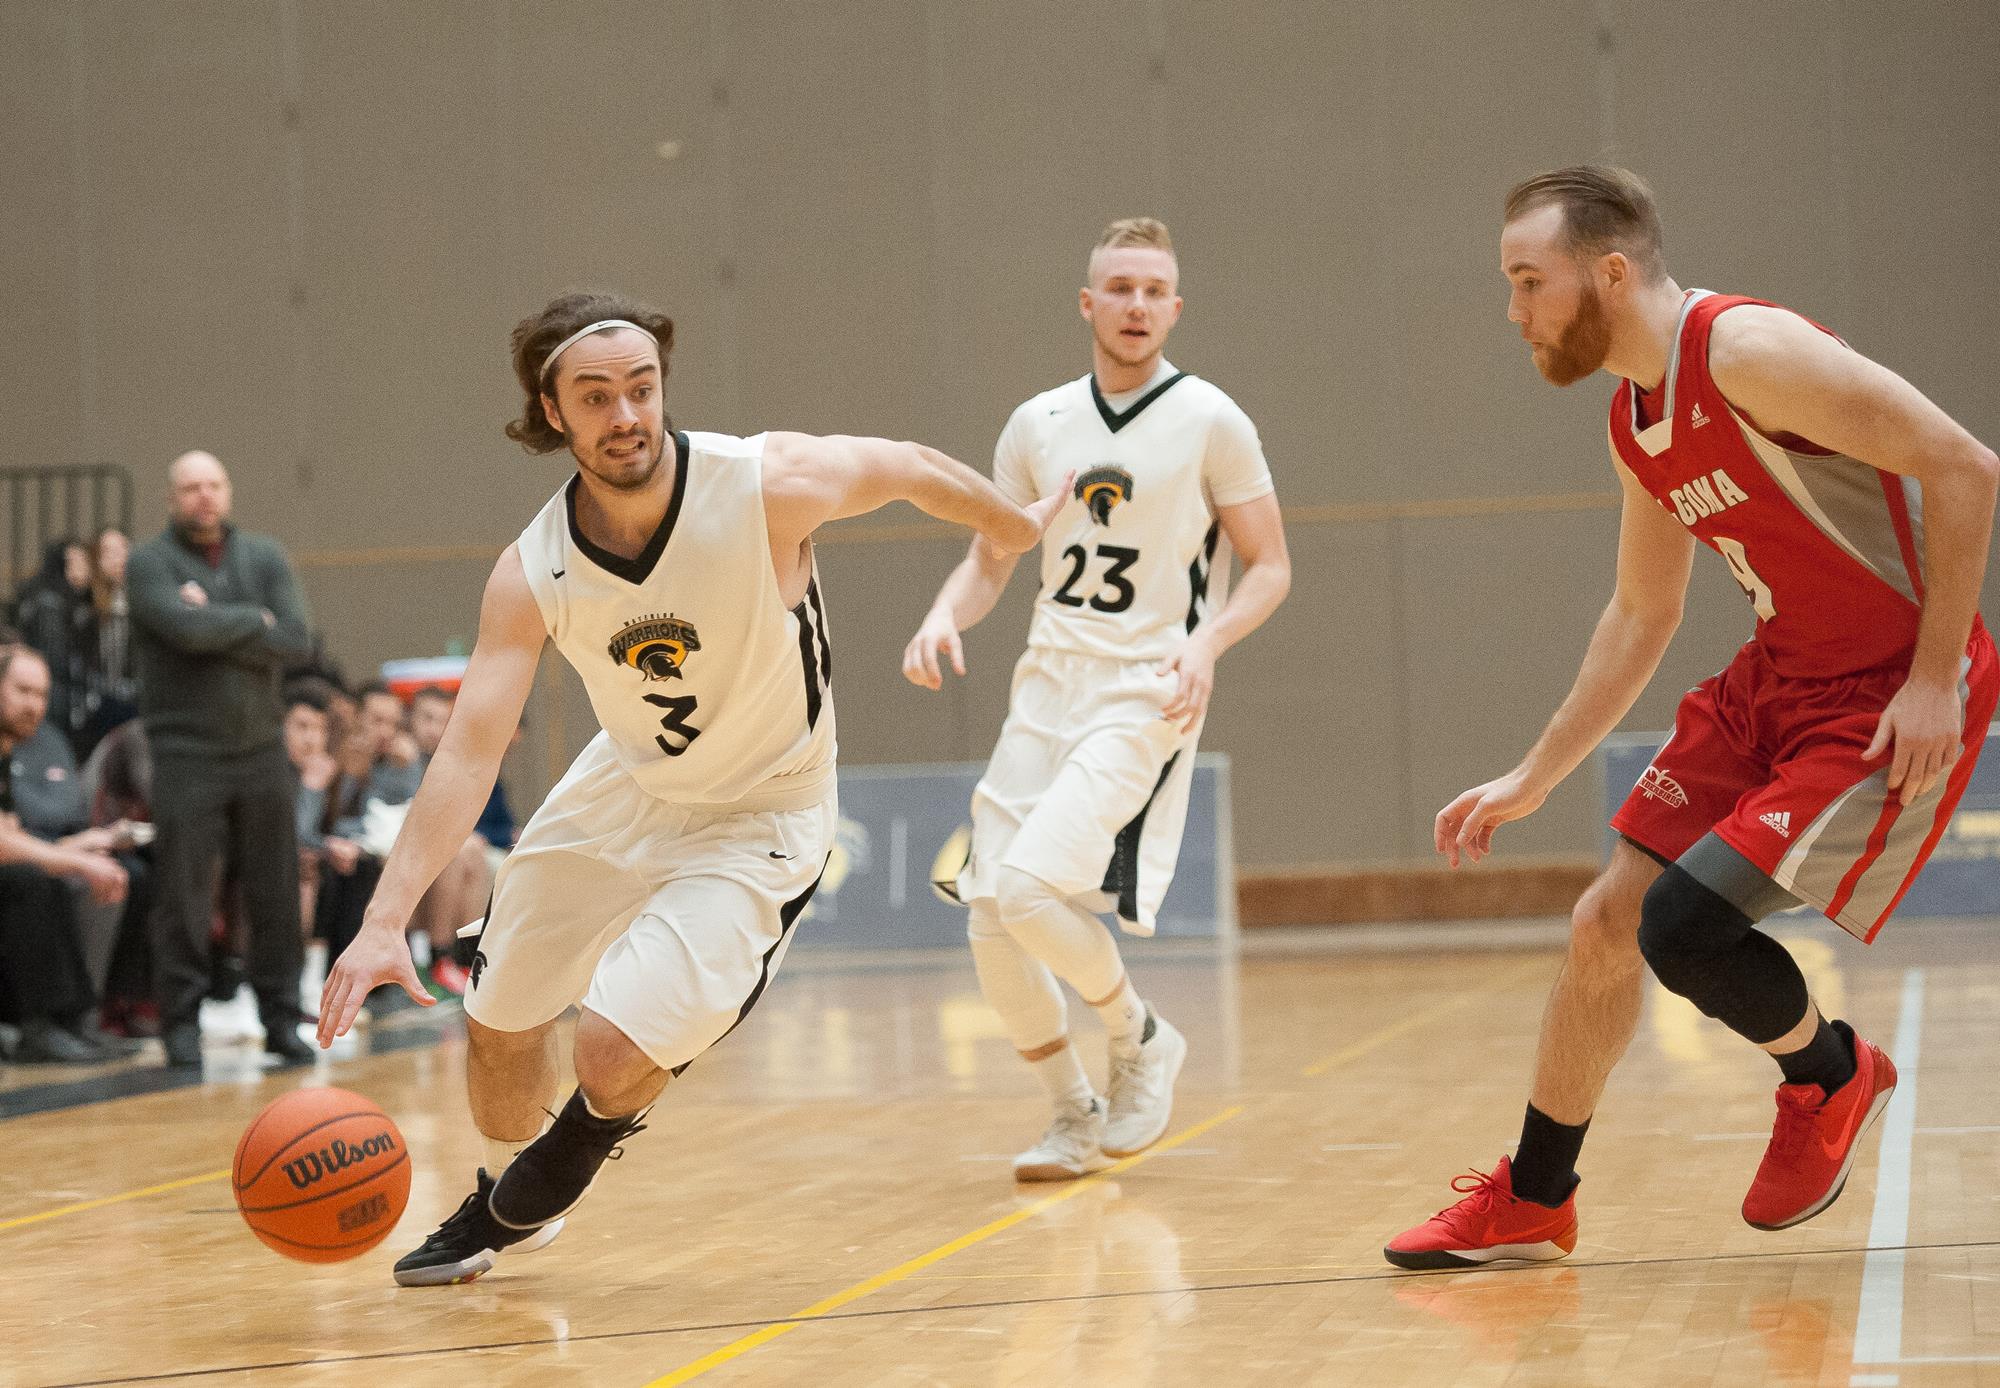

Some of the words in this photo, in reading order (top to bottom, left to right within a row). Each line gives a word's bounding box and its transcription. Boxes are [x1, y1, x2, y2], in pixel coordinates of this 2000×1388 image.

[1657, 468, 1749, 527] GOMA
[1053, 543, 1140, 613] 23
[608, 622, 701, 666] WARRIORS
[642, 693, 701, 757] 3
[1640, 778, 1683, 808] NDERBIRDS
[1758, 813, 1791, 838] adidas
[281, 1131, 396, 1189] Wilson
